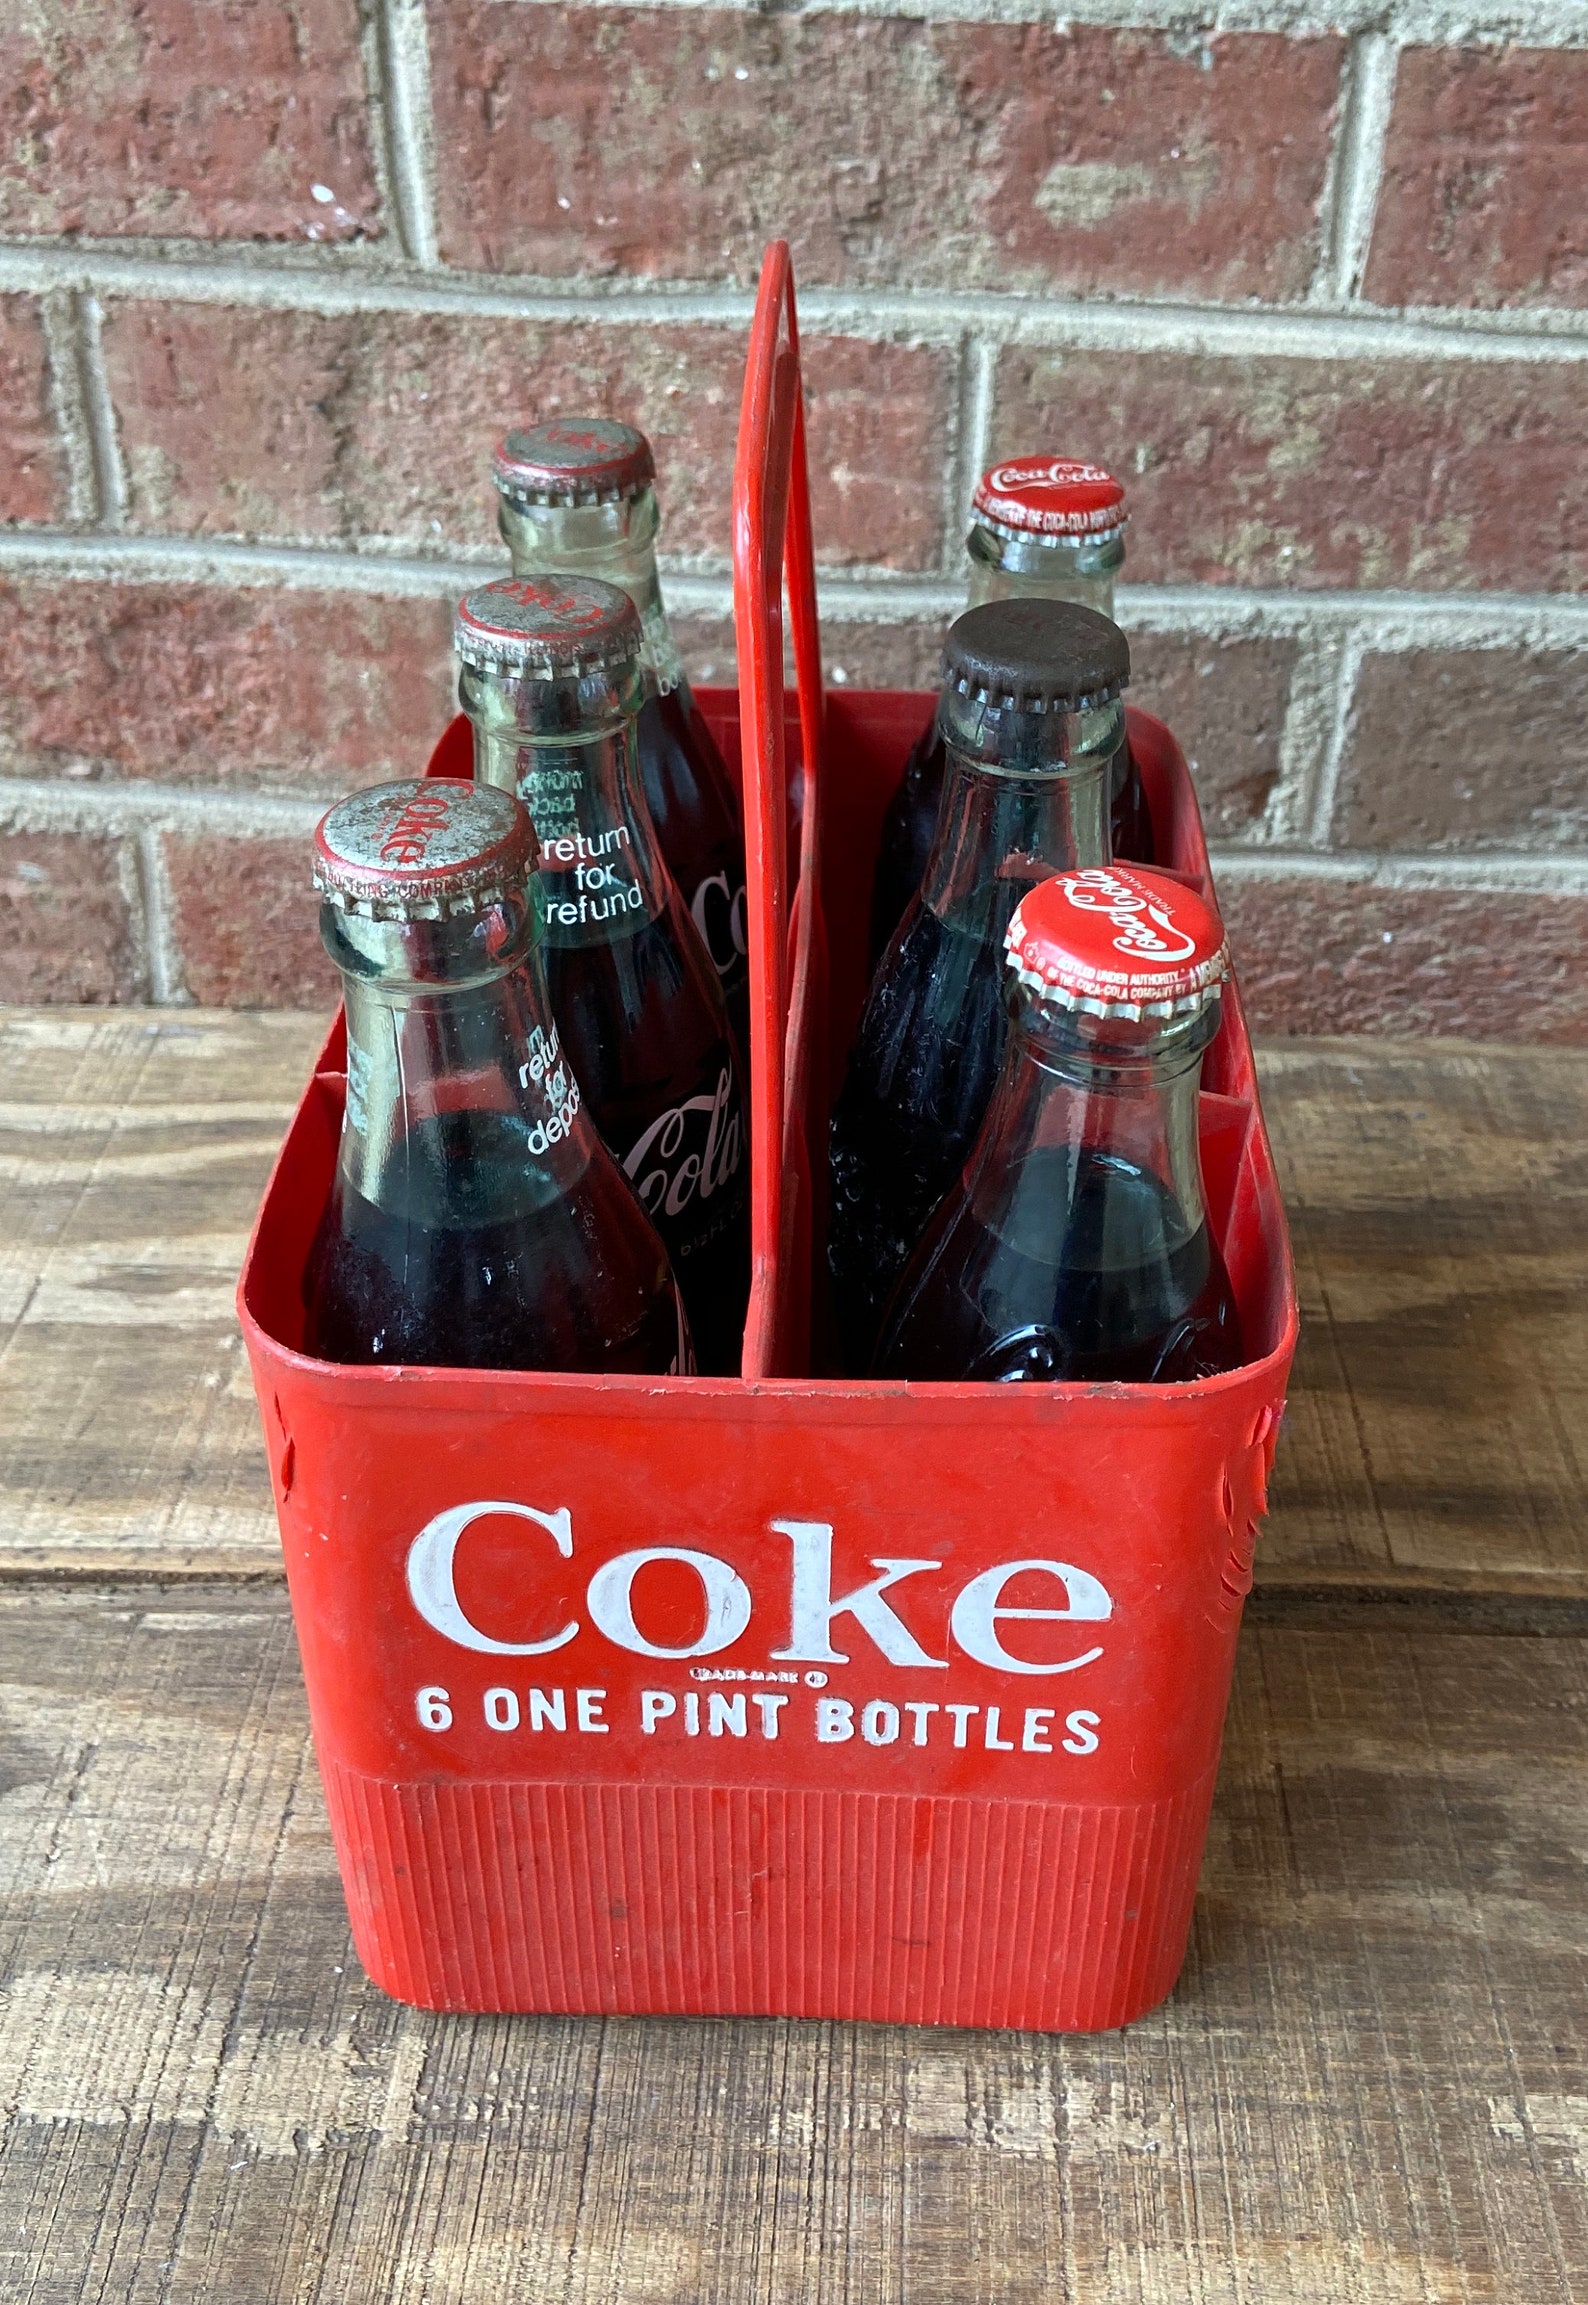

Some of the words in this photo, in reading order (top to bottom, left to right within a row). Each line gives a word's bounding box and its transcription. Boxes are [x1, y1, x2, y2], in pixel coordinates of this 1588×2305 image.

[991, 464, 1110, 492] Coca-Cola
[380, 779, 475, 864] Coke
[543, 825, 631, 861] return
[574, 862, 616, 891] for
[546, 879, 644, 926] refund
[1055, 869, 1196, 963] Coca-Cola
[1047, 968, 1059, 981] OF
[1059, 972, 1076, 988] THE
[1076, 978, 1128, 1000] COCA-COLA
[1130, 984, 1174, 1000] COMPANY
[1057, 957, 1096, 979] BOTTLED
[1096, 970, 1129, 986] UNDER
[1130, 970, 1179, 987] AUTHORITY
[406, 1500, 1113, 1676] Coke
[415, 1686, 453, 1732] 6
[483, 1687, 610, 1733] ONE
[641, 1690, 790, 1740] PINT
[815, 1696, 1102, 1755] BOTTLES
